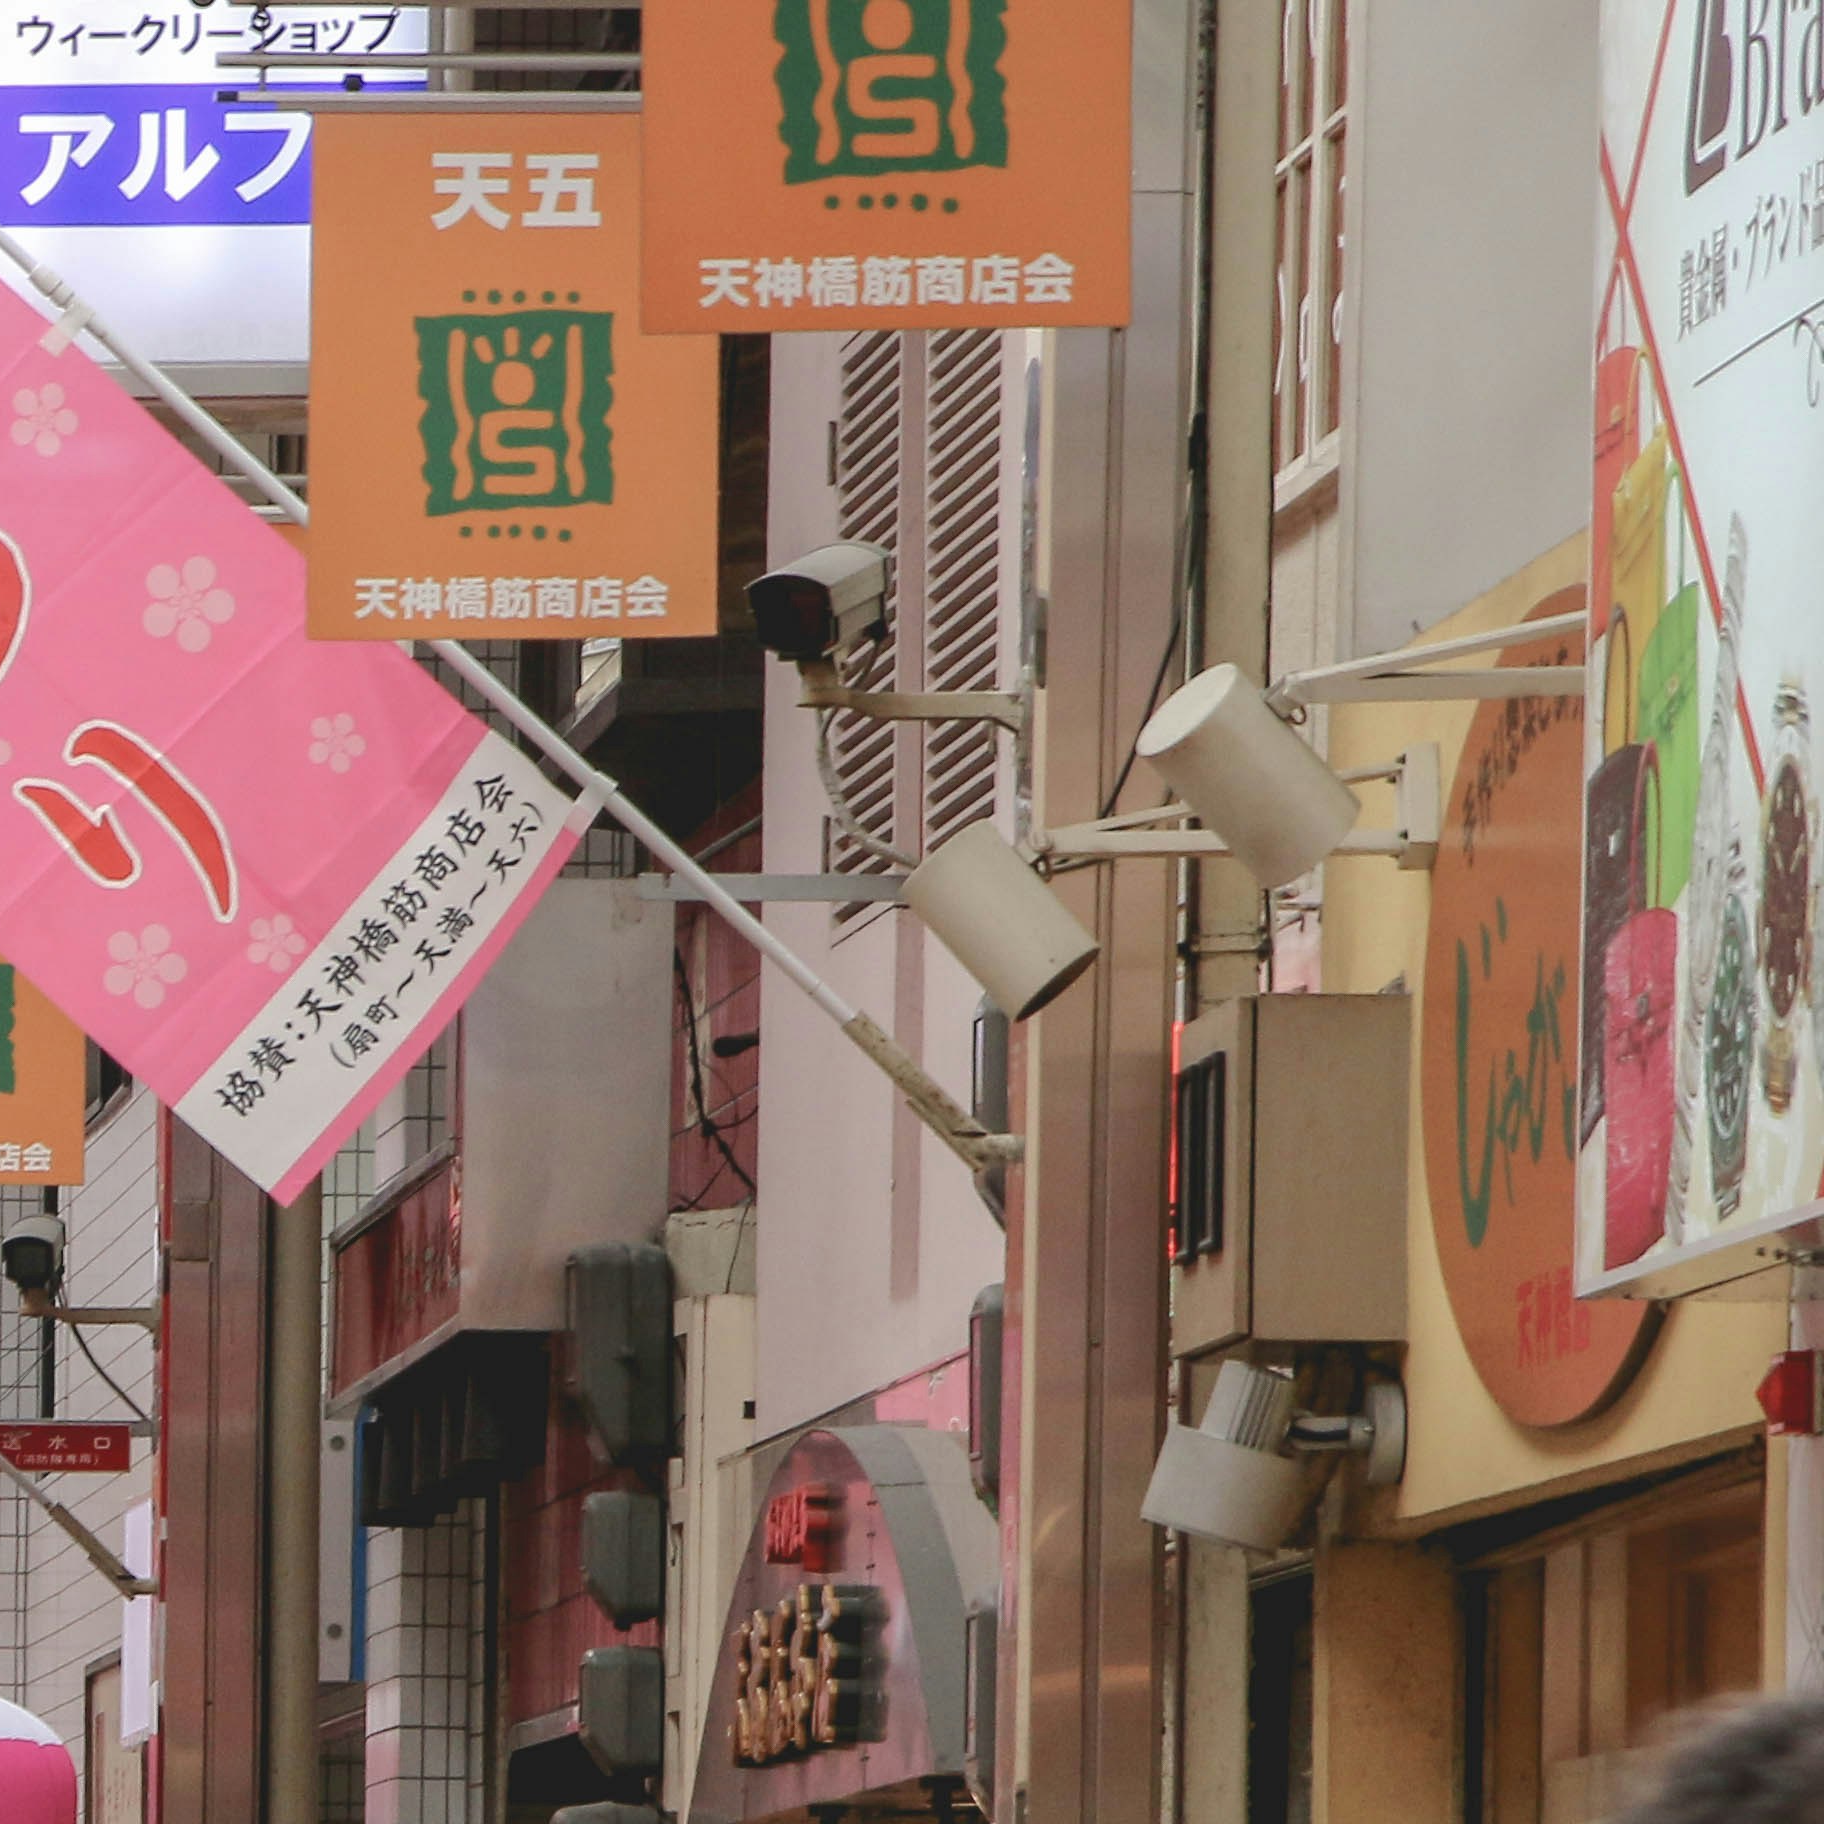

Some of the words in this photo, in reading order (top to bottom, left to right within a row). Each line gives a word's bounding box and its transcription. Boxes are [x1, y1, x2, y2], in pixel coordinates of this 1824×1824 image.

[16, 12, 400, 56] ウィークリーショップ
[429, 151, 604, 232] 天五
[698, 254, 1076, 309] 天神橋筋商店会
[352, 576, 670, 623] 天神橋筋商店会
[216, 773, 520, 1120] 協賛：天神橋筋商店会
[1454, 895, 1578, 1252] じゃが
